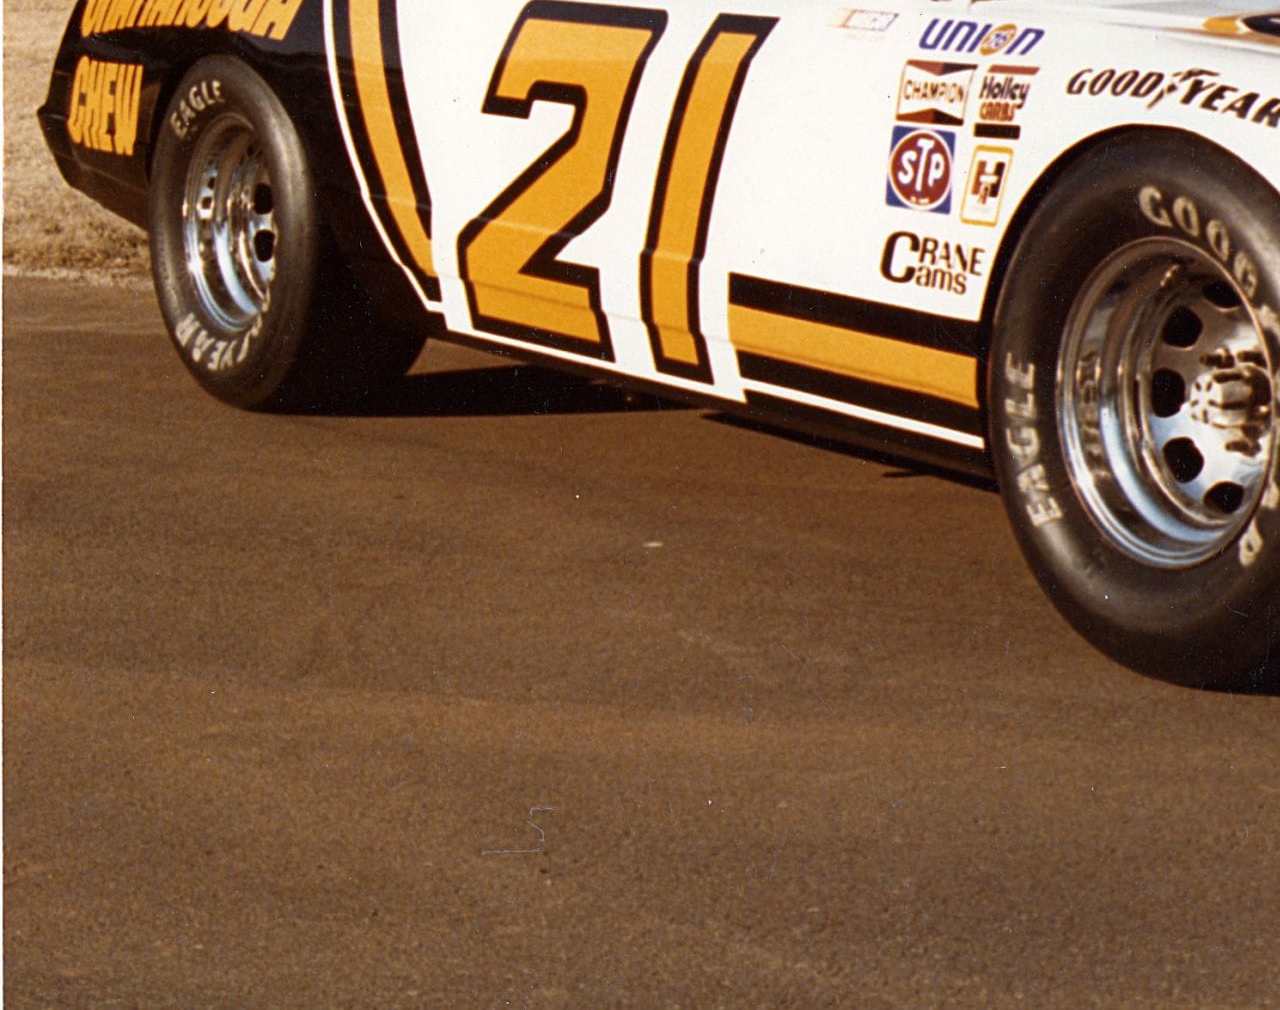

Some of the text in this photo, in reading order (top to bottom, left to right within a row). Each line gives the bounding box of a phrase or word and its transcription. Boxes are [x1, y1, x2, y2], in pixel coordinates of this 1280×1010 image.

[69, 54, 143, 157] CHEW
[170, 79, 225, 139] EAGLE
[903, 79, 965, 104] CHAMPION
[897, 138, 946, 193] STP
[1005, 352, 1064, 527] EAGLE
